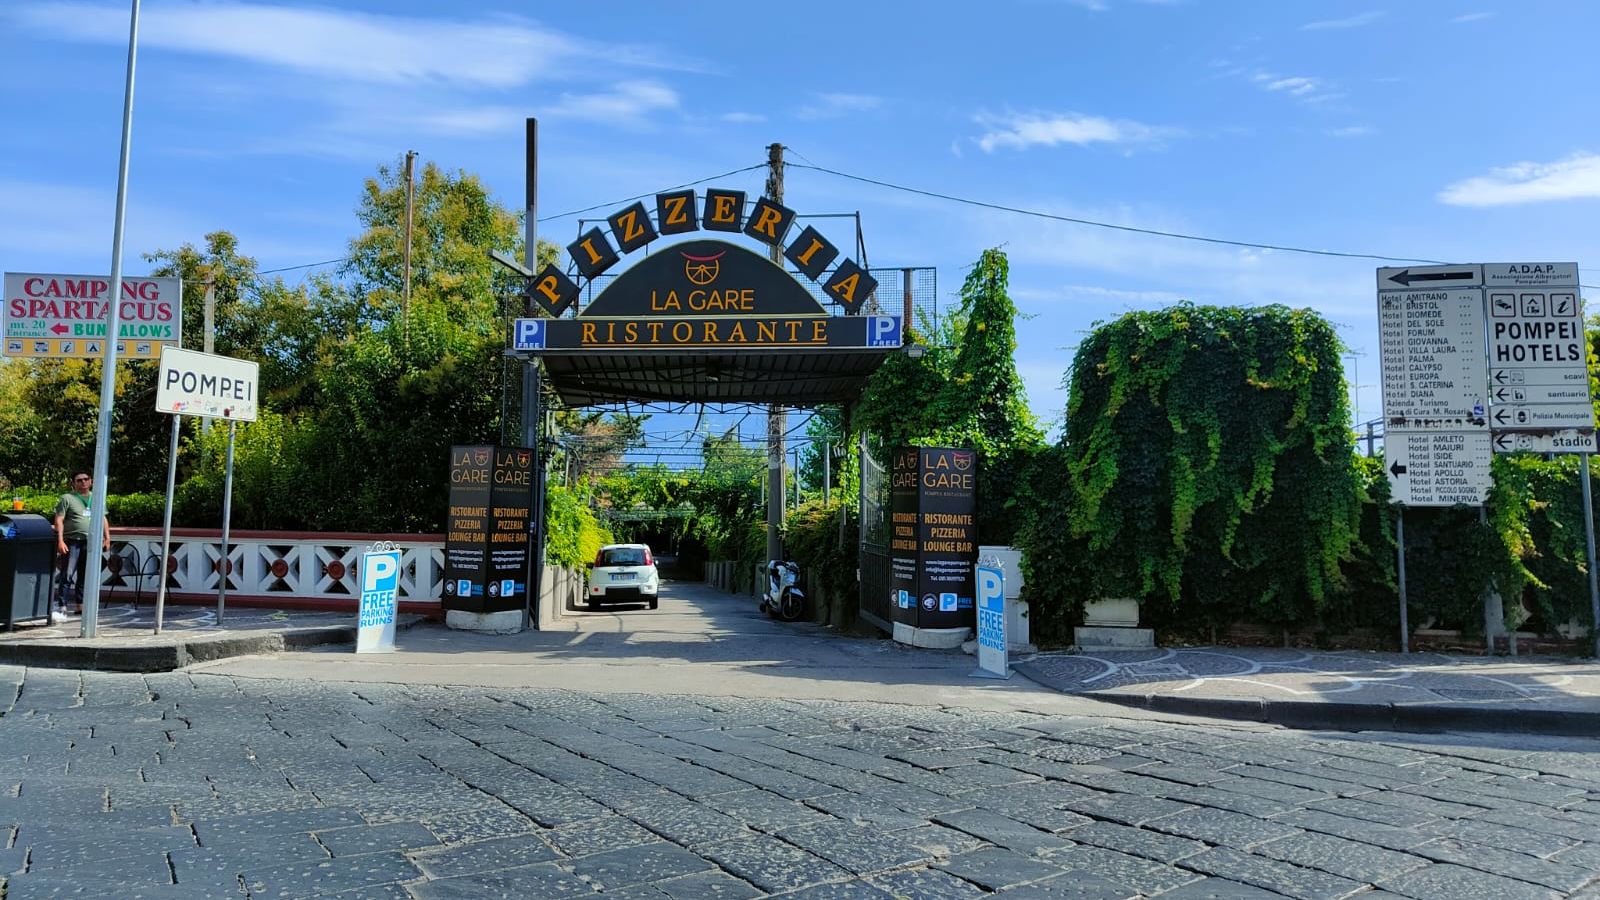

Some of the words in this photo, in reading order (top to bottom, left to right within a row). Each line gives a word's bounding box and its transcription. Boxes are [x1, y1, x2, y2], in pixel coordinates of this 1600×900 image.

[536, 195, 861, 305] PIZZERIA
[1509, 265, 1555, 274] A.D.A.P.
[24, 278, 160, 300] CAMPNG
[651, 290, 682, 311] LA
[688, 289, 755, 311] GARE
[1406, 302, 1439, 310] BRISTOL
[32, 320, 46, 329] 20
[74, 323, 171, 338] BUNALOWS
[520, 320, 538, 342] P
[876, 316, 895, 340] P
[1495, 322, 1577, 339] POMPEI
[581, 321, 828, 343] RISTORANTE
[1409, 346, 1428, 354] VILLA
[1497, 344, 1580, 362] HOTELS
[166, 368, 252, 401] POMPEI
[1419, 381, 1453, 389] CATERINA
[1548, 390, 1587, 398] santuario
[1554, 412, 1590, 420] Municipale
[1553, 435, 1592, 447] stadio
[453, 452, 471, 466] LA
[497, 452, 514, 466] LA
[926, 454, 949, 469] LA
[451, 469, 488, 483] GARE
[494, 470, 530, 485] GARE
[892, 473, 917, 487] GARE
[923, 472, 972, 489] GARE
[450, 507, 487, 517] RISTORANTE
[494, 508, 528, 517] RISTORANTE
[924, 513, 972, 525] RISTORANTE
[454, 519, 480, 529] PIZZERIA
[497, 520, 523, 529] PIZZERIA
[449, 532, 471, 541] LOUNGE
[472, 533, 486, 542] BAR
[492, 533, 514, 542] LOUNGE
[516, 533, 527, 542] BAR
[931, 528, 966, 538] PIZZERIA
[924, 541, 955, 552] LOUNGE
[957, 542, 972, 552] BAR
[365, 555, 396, 591] P
[979, 570, 1002, 608] P
[363, 592, 393, 609] FREE
[943, 594, 955, 609] P
[362, 606, 393, 619] PARKING
[361, 616, 392, 627] RUINS
[980, 611, 1002, 631] FREE
[980, 627, 1004, 643] PARKING
[980, 638, 1004, 651] RUINS
